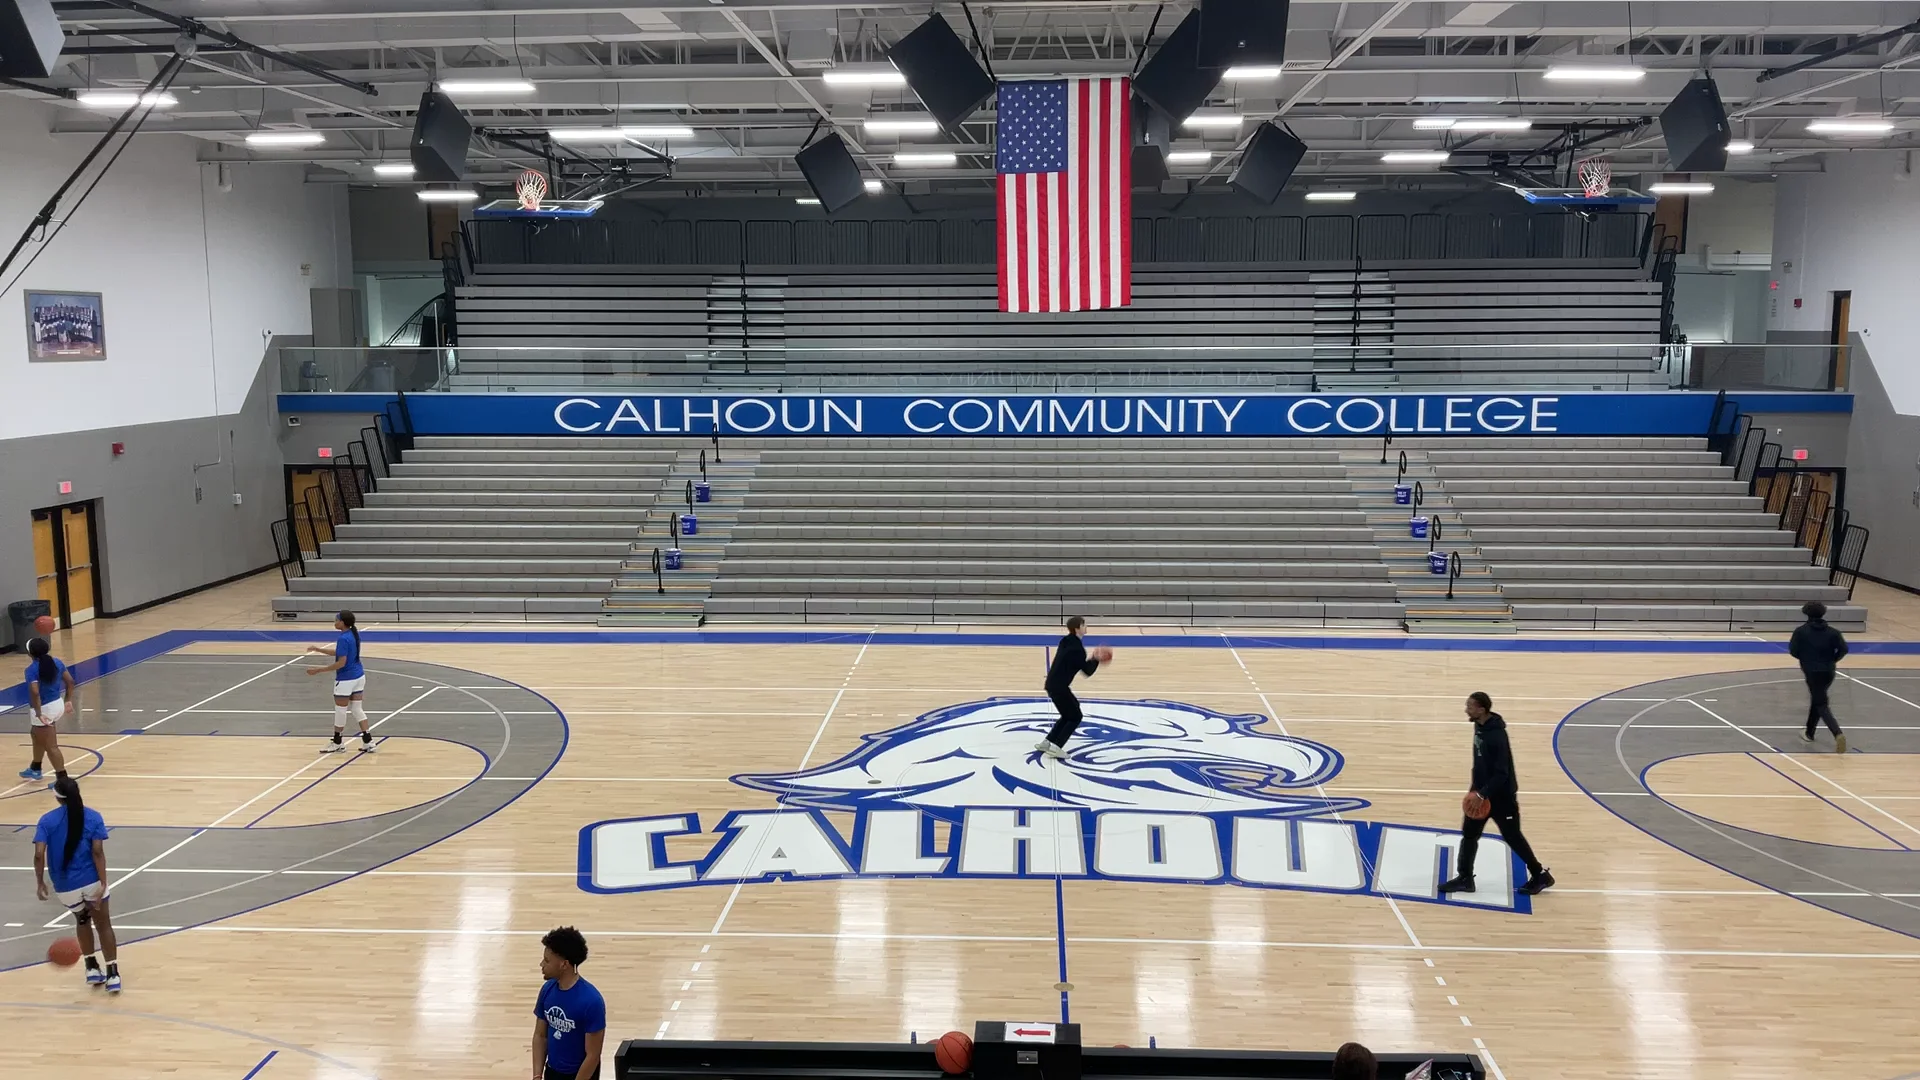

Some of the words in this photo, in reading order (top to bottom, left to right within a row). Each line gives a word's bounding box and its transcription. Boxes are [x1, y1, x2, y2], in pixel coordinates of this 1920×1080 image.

[554, 398, 862, 432] CALHOUN
[904, 399, 1246, 432] COMMUNITY
[1287, 397, 1558, 433] COLLEGE
[577, 808, 1532, 915] CALHOUN
